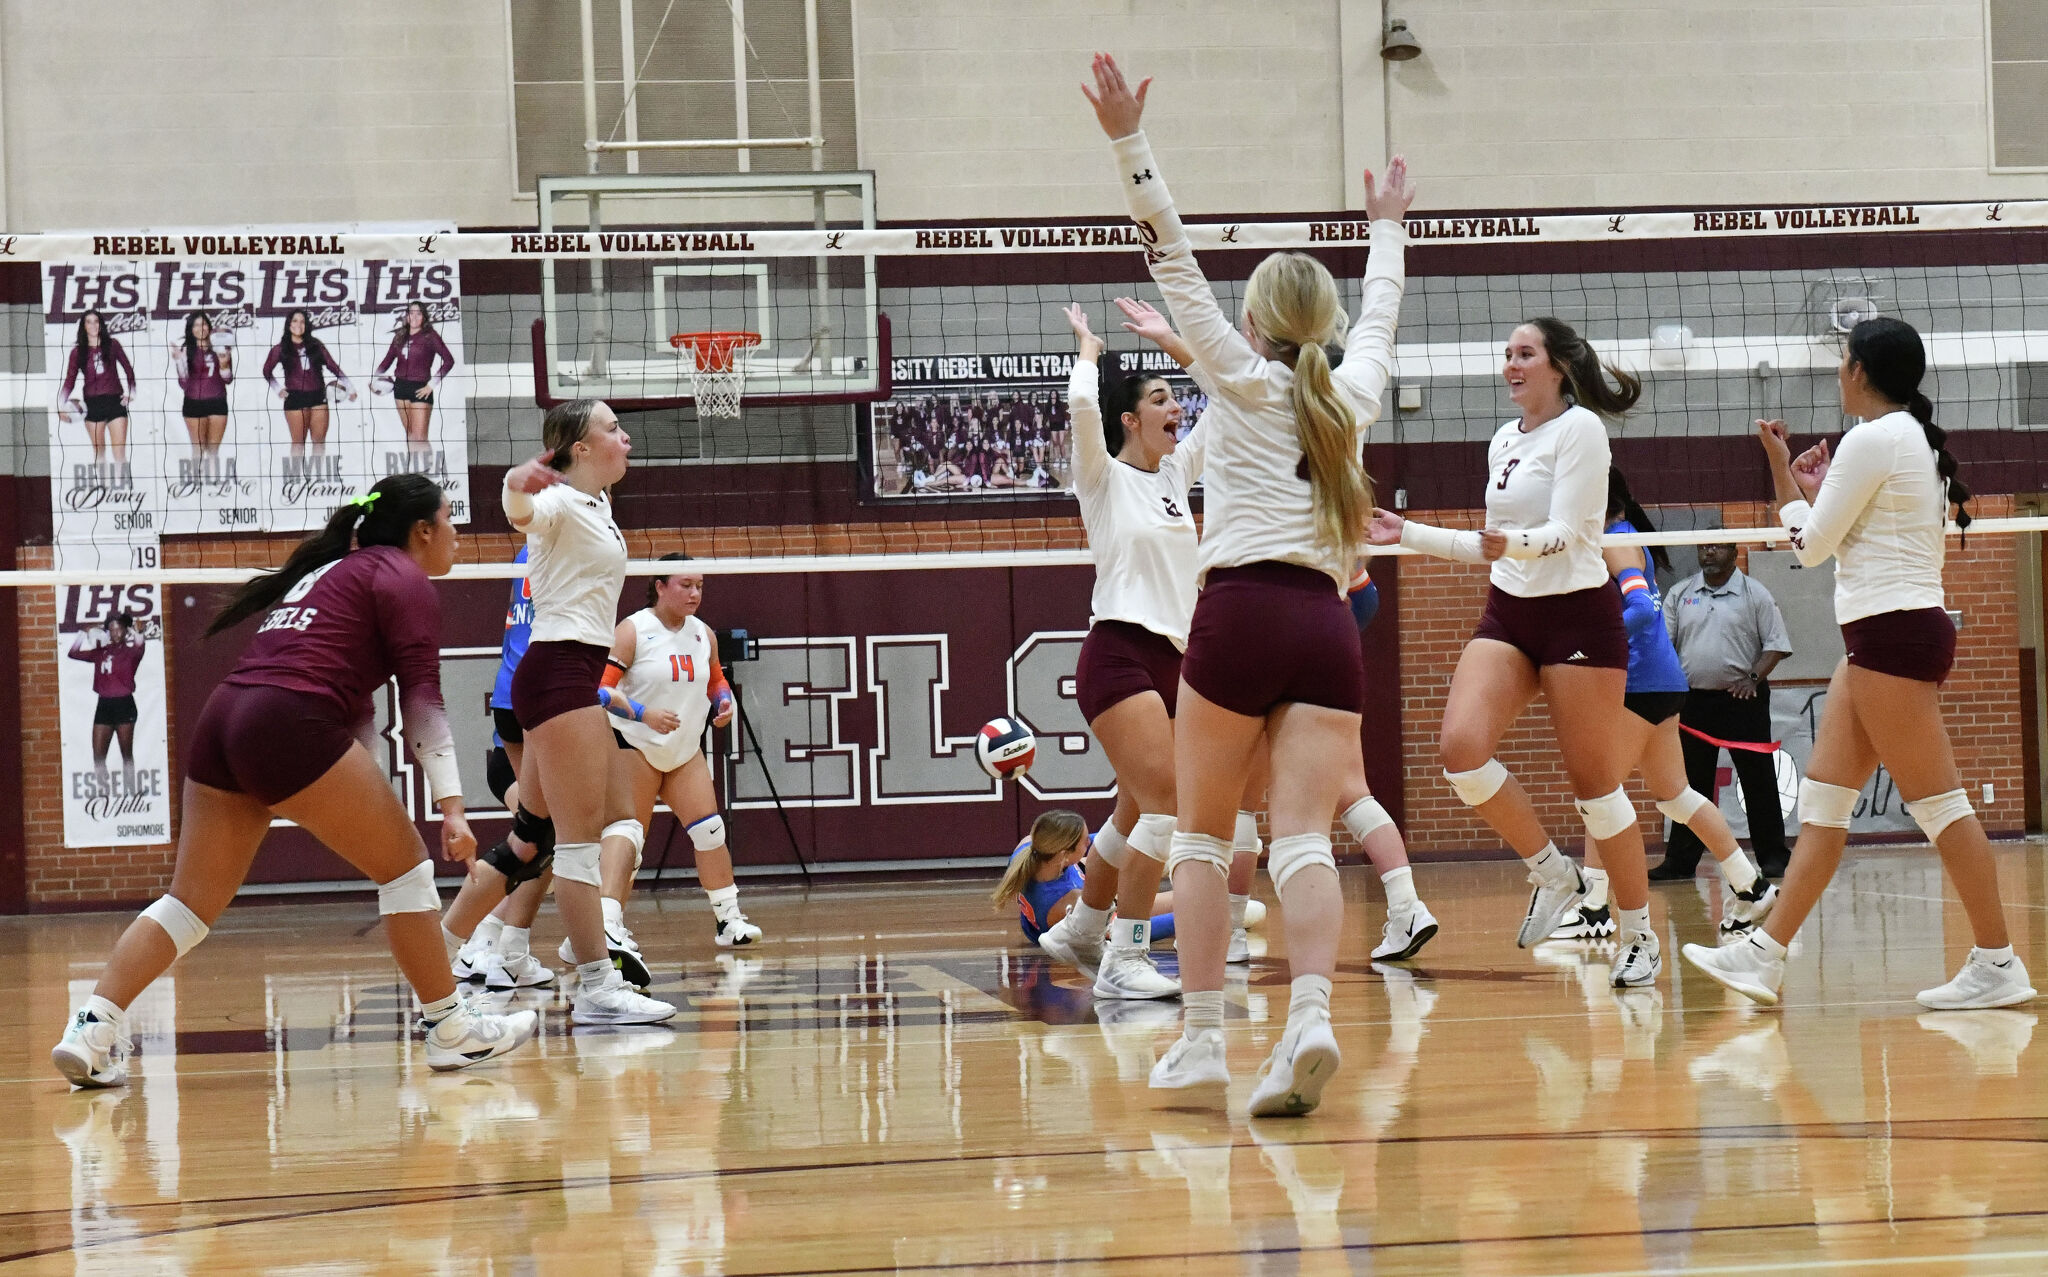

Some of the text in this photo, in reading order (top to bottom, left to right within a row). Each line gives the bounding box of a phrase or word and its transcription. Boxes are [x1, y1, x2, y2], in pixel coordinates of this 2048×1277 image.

[1309, 218, 1540, 241] REBE OLLEYBALL
[1693, 206, 1920, 231] REBEL VOLLEYBALL
[93, 235, 345, 255] REBEL VOLLEYBALL
[511, 233, 755, 253] REBEL VOLLEYBALL
[916, 230, 992, 248] REBEL
[1000, 227, 1143, 247] VOLLEYBAL
[46, 265, 147, 323] LHS
[151, 261, 253, 320] LHS
[256, 260, 355, 317] LHS
[360, 259, 459, 314] LHS
[892, 354, 1079, 380] RSITY REBEL VOLLEYBA
[1142, 353, 1181, 370] MARO
[73, 463, 133, 491] BELLA
[179, 457, 238, 486] BELLA
[282, 455, 343, 483] MYLIE
[114, 512, 153, 530] SENIOR
[219, 507, 257, 525] SENIOR
[137, 546, 156, 569] 19
[669, 654, 695, 682] 14
[73, 769, 161, 799] ESSENCE
[117, 824, 165, 838] SOPHOMORE
